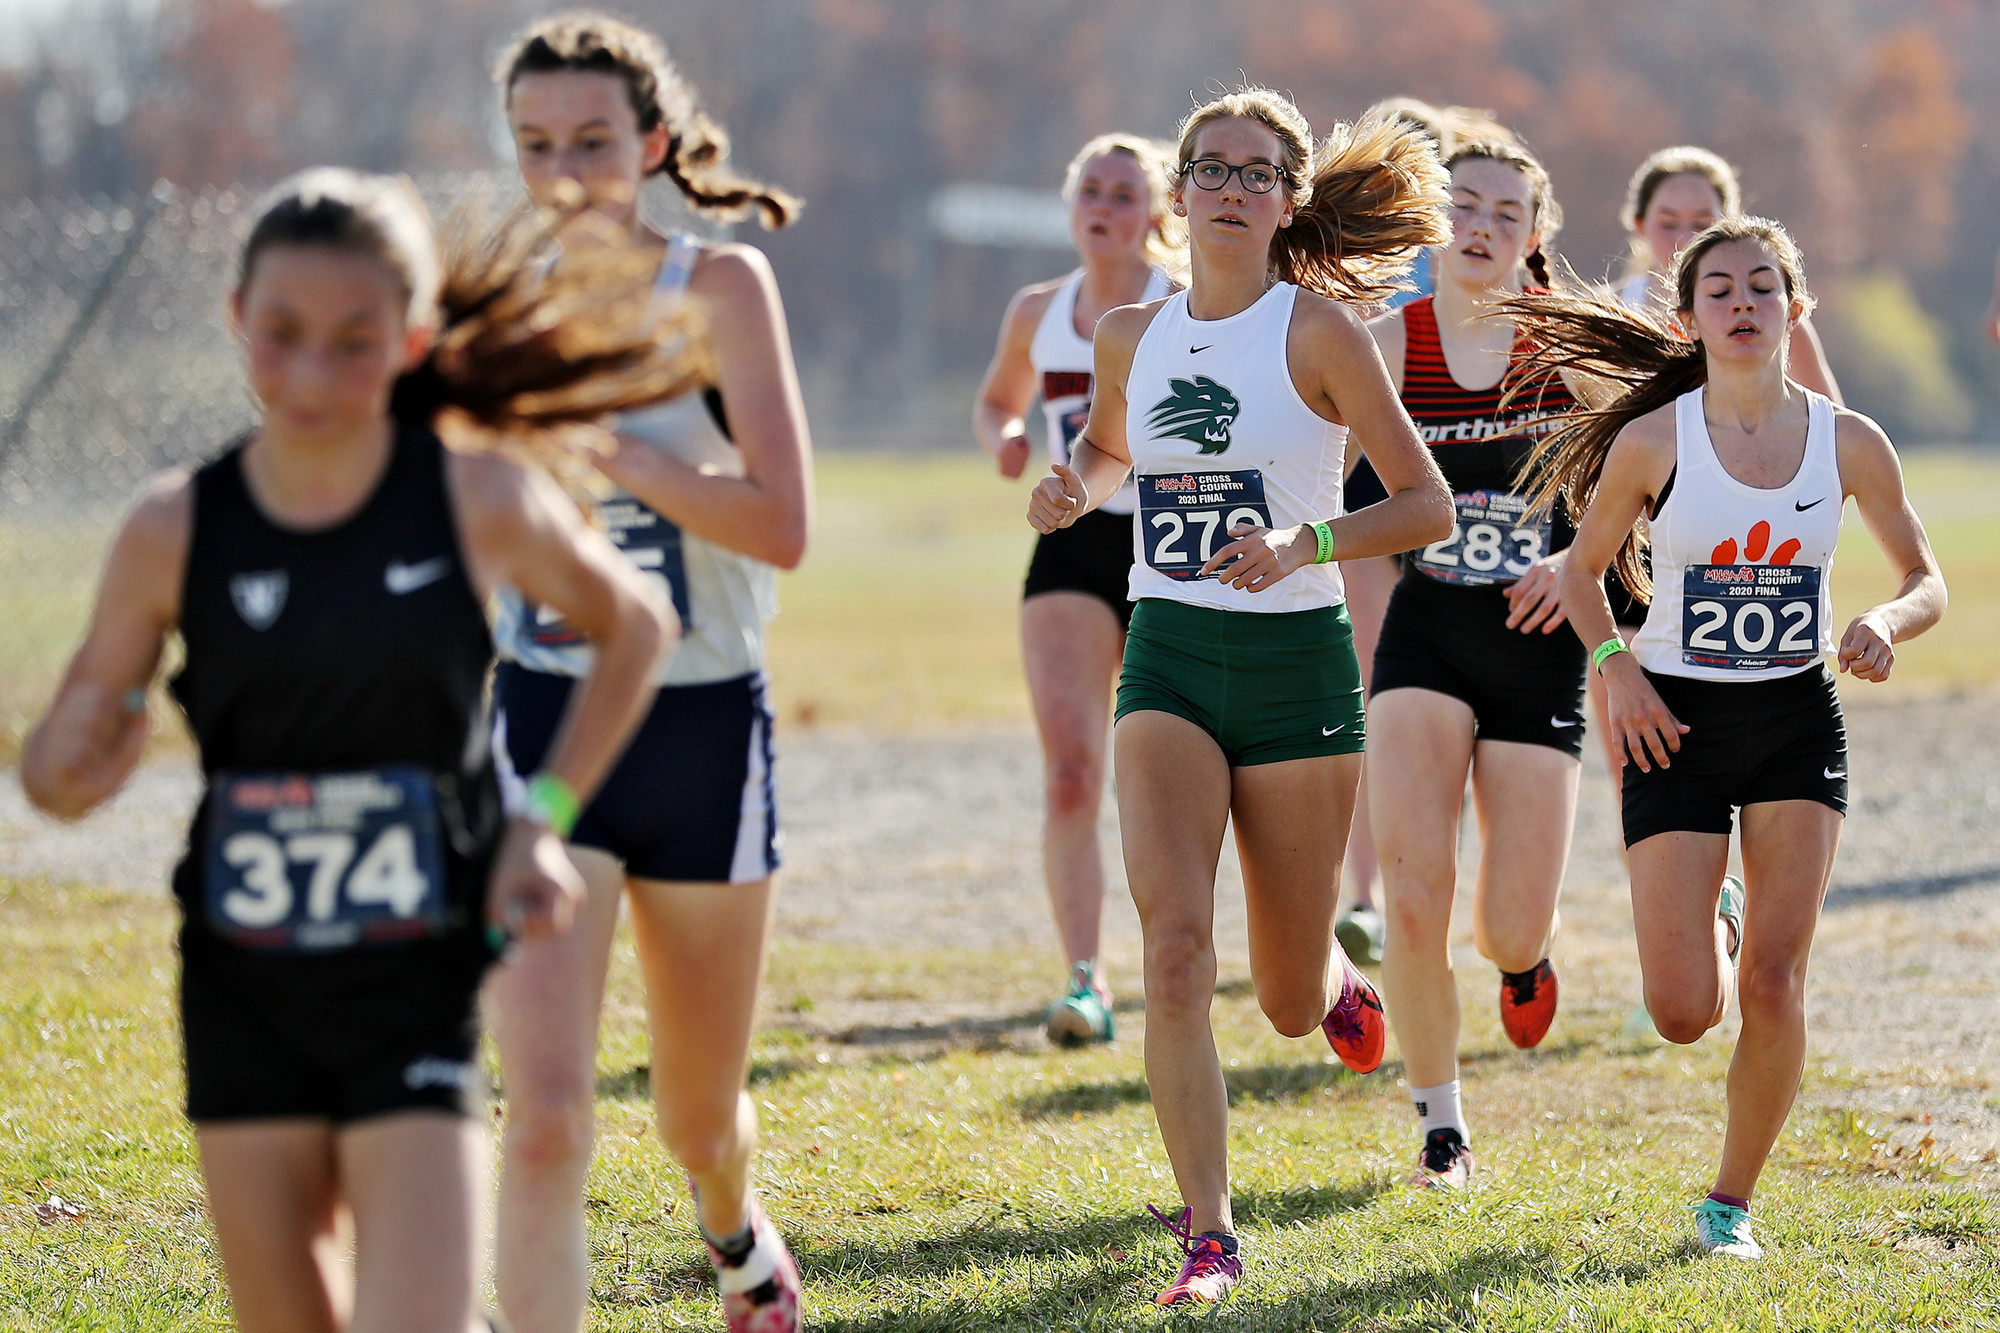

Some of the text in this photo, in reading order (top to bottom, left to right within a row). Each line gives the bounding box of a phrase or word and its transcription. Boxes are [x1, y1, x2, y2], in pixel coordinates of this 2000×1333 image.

[1416, 410, 1567, 443] orthville
[1199, 475, 1231, 483] CROSS
[1200, 483, 1244, 492] COUNTRY
[1178, 493, 1226, 504] 2020 FINAL
[1422, 523, 1543, 577] 283
[1758, 568, 1792, 577] CROSS
[1758, 575, 1803, 585] COUNTRY
[1728, 586, 1782, 596] 2020 FINAL
[1689, 600, 1814, 653] 202
[223, 824, 430, 929] 374
